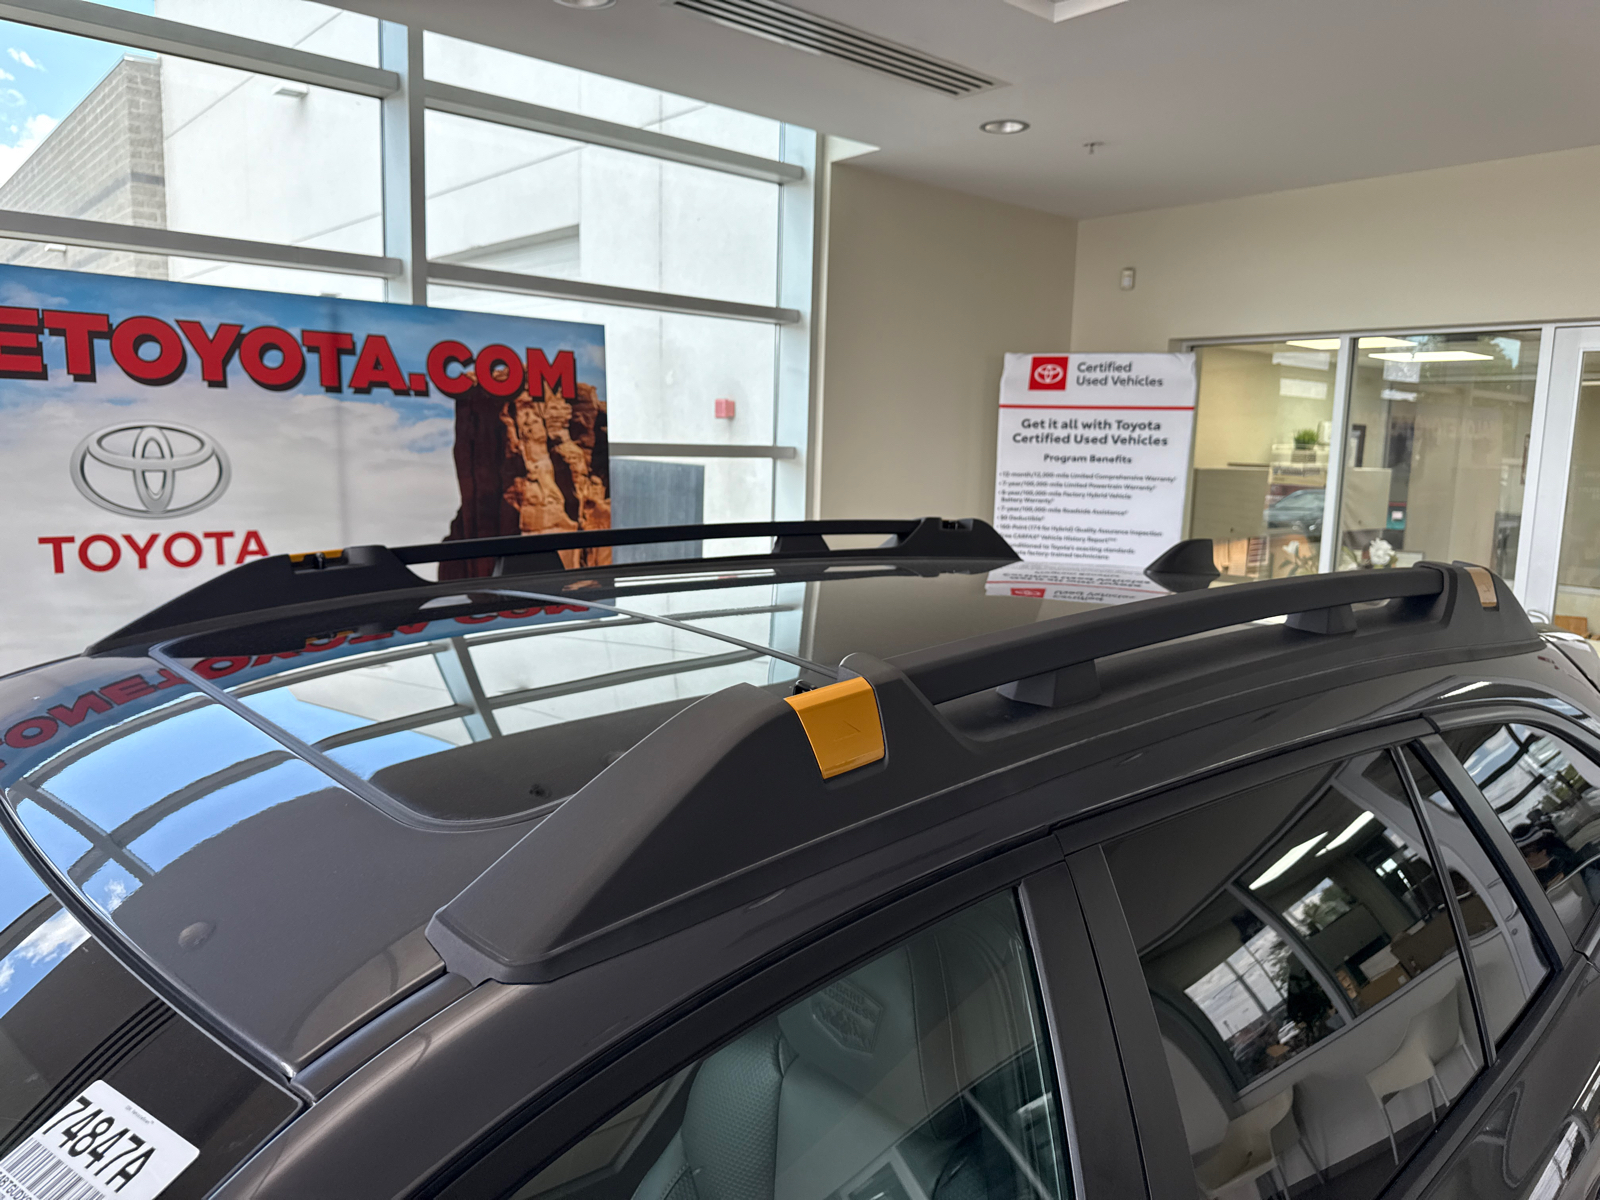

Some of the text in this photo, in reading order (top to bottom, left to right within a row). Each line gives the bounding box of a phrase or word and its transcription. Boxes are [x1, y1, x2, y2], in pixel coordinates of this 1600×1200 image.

[1076, 361, 1132, 374] Certified
[1075, 375, 1164, 387] Used Vehicles
[1020, 418, 1161, 433] Get it all with Toyota
[1012, 432, 1168, 447] Certified Used Vehicles
[1043, 453, 1132, 465] Program Benefits
[38, 530, 268, 573] TOYOTA
[42, 1095, 156, 1194] 74847A
